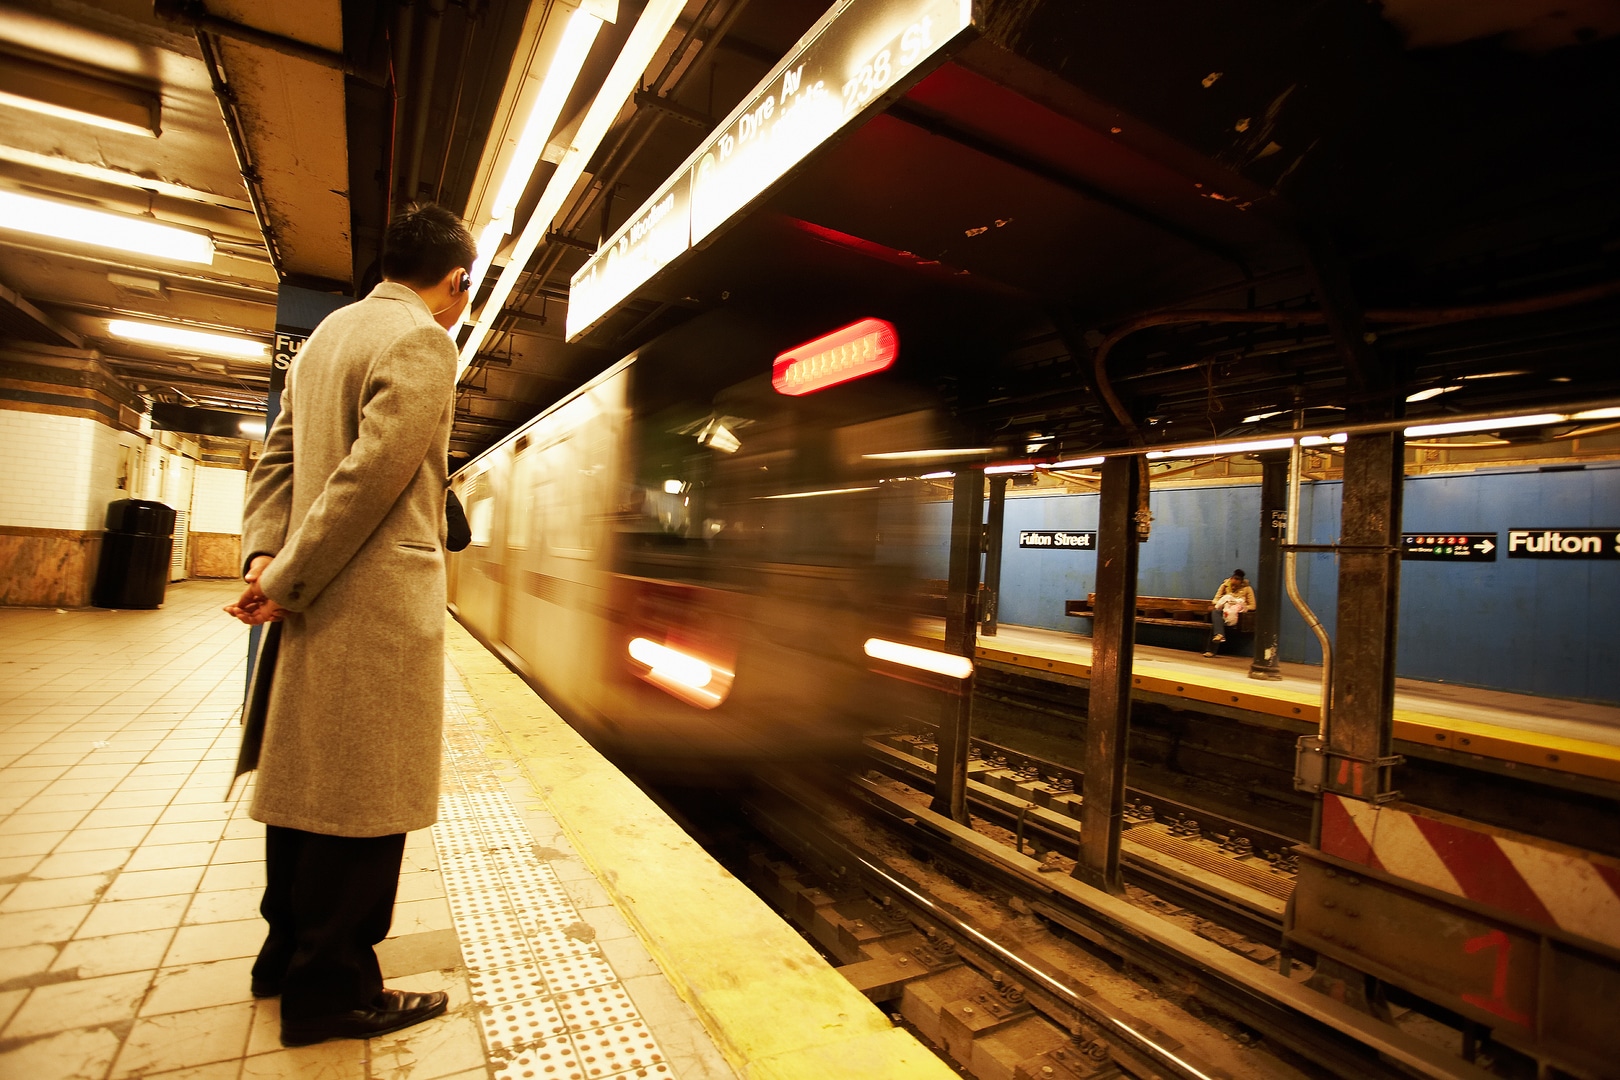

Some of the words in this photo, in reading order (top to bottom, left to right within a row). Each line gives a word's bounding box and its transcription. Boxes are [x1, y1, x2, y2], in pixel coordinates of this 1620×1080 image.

[843, 49, 891, 115] 238
[900, 14, 932, 67] St
[717, 133, 734, 162] To
[738, 95, 775, 145] Dyre
[780, 65, 803, 105] Av
[1019, 532, 1052, 546] Fulton
[1054, 532, 1090, 546] Street
[1508, 531, 1603, 553] Fulton
